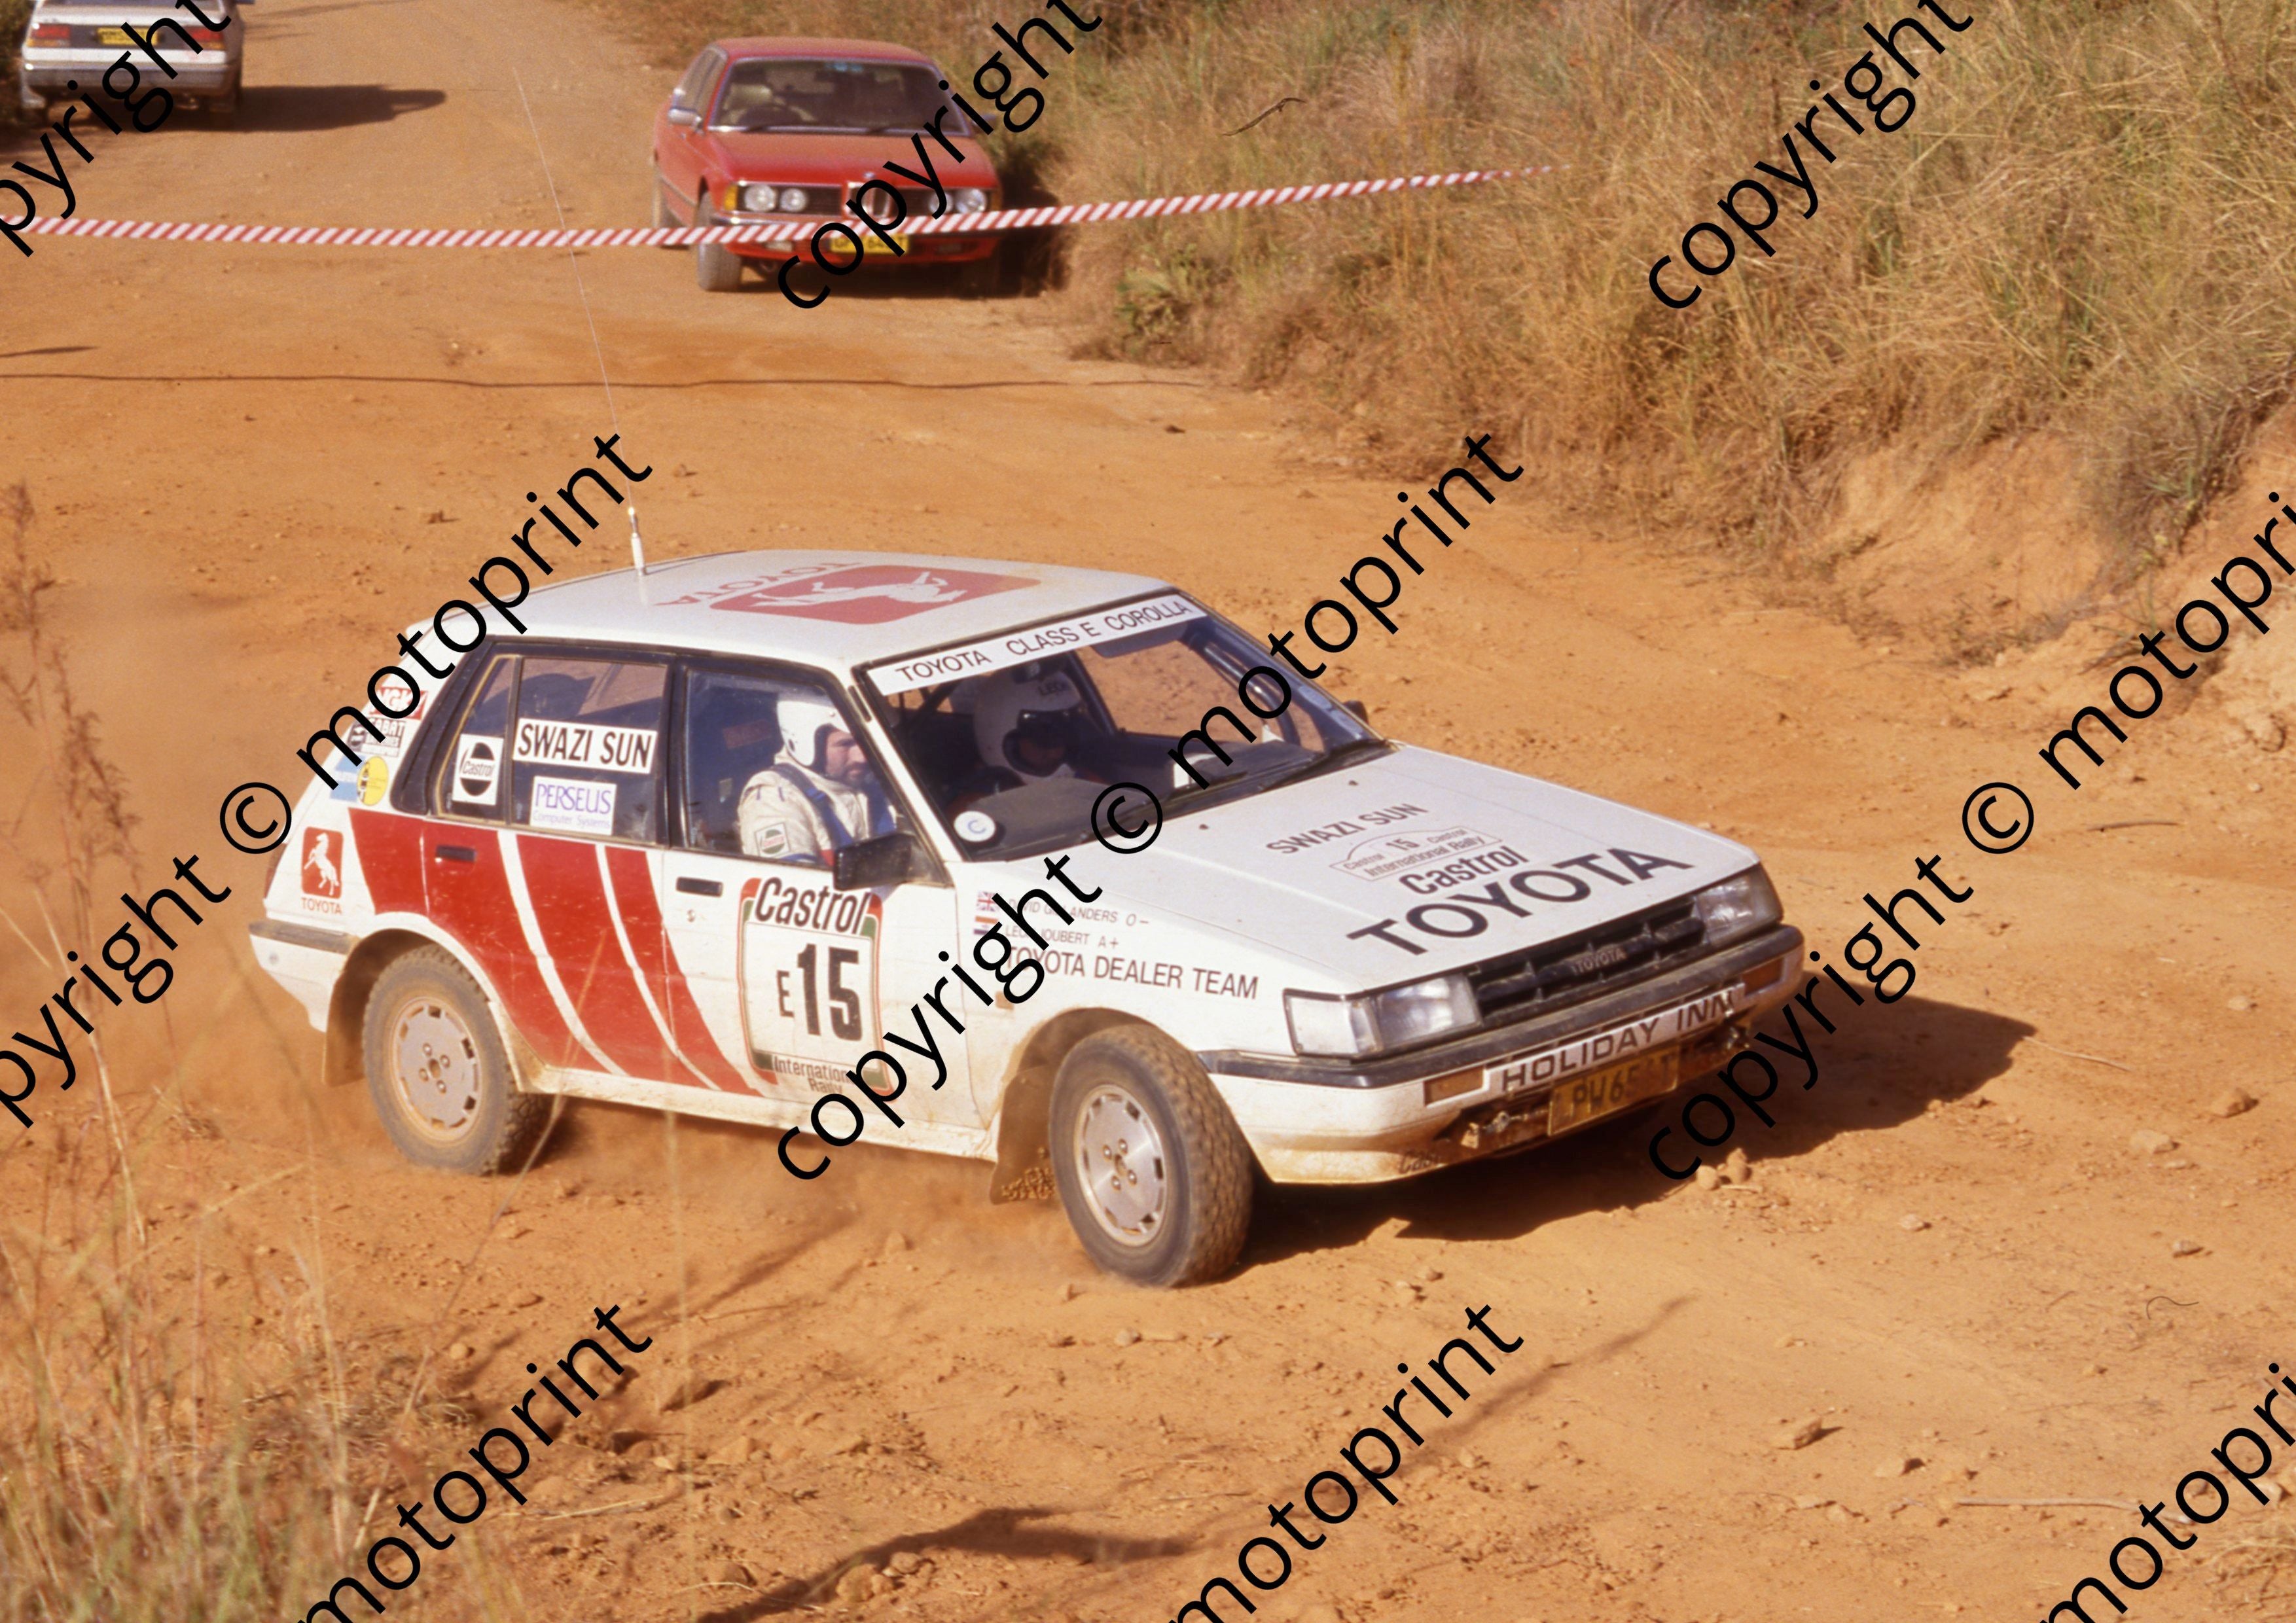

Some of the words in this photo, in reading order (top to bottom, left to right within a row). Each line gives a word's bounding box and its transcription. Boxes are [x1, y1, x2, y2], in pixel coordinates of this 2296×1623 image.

[655, 562, 861, 606] TOYOTA
[895, 650, 992, 683] TOYOTA
[1006, 626, 1080, 656] CLASS
[1079, 622, 1102, 637] E
[1104, 600, 1193, 630] COROLLA
[518, 723, 592, 762] SWAZI
[600, 731, 652, 768] SUN
[462, 760, 495, 777] Castrol
[535, 783, 611, 814] PERSEUS
[1266, 820, 1368, 855] SWAZI
[1358, 804, 1429, 827] SUN
[1386, 838, 1420, 851] 15
[1364, 846, 1450, 877] International
[1447, 836, 1486, 851] Rally
[1399, 846, 1530, 896] Castrol
[301, 897, 342, 915] TOYOTA
[755, 876, 870, 935] Castrol
[1345, 847, 1696, 956] TOYOTA
[1008, 946, 1085, 977] TOYOTA
[1094, 955, 1182, 989] DEALER
[1193, 967, 1259, 1000] TEAM
[1571, 946, 1627, 976] TOYOTA
[1503, 1016, 1660, 1092] HOLIDAY
[1677, 990, 1733, 1031] INN
[774, 1055, 853, 1085] Internation
[808, 1077, 843, 1095] Rally
